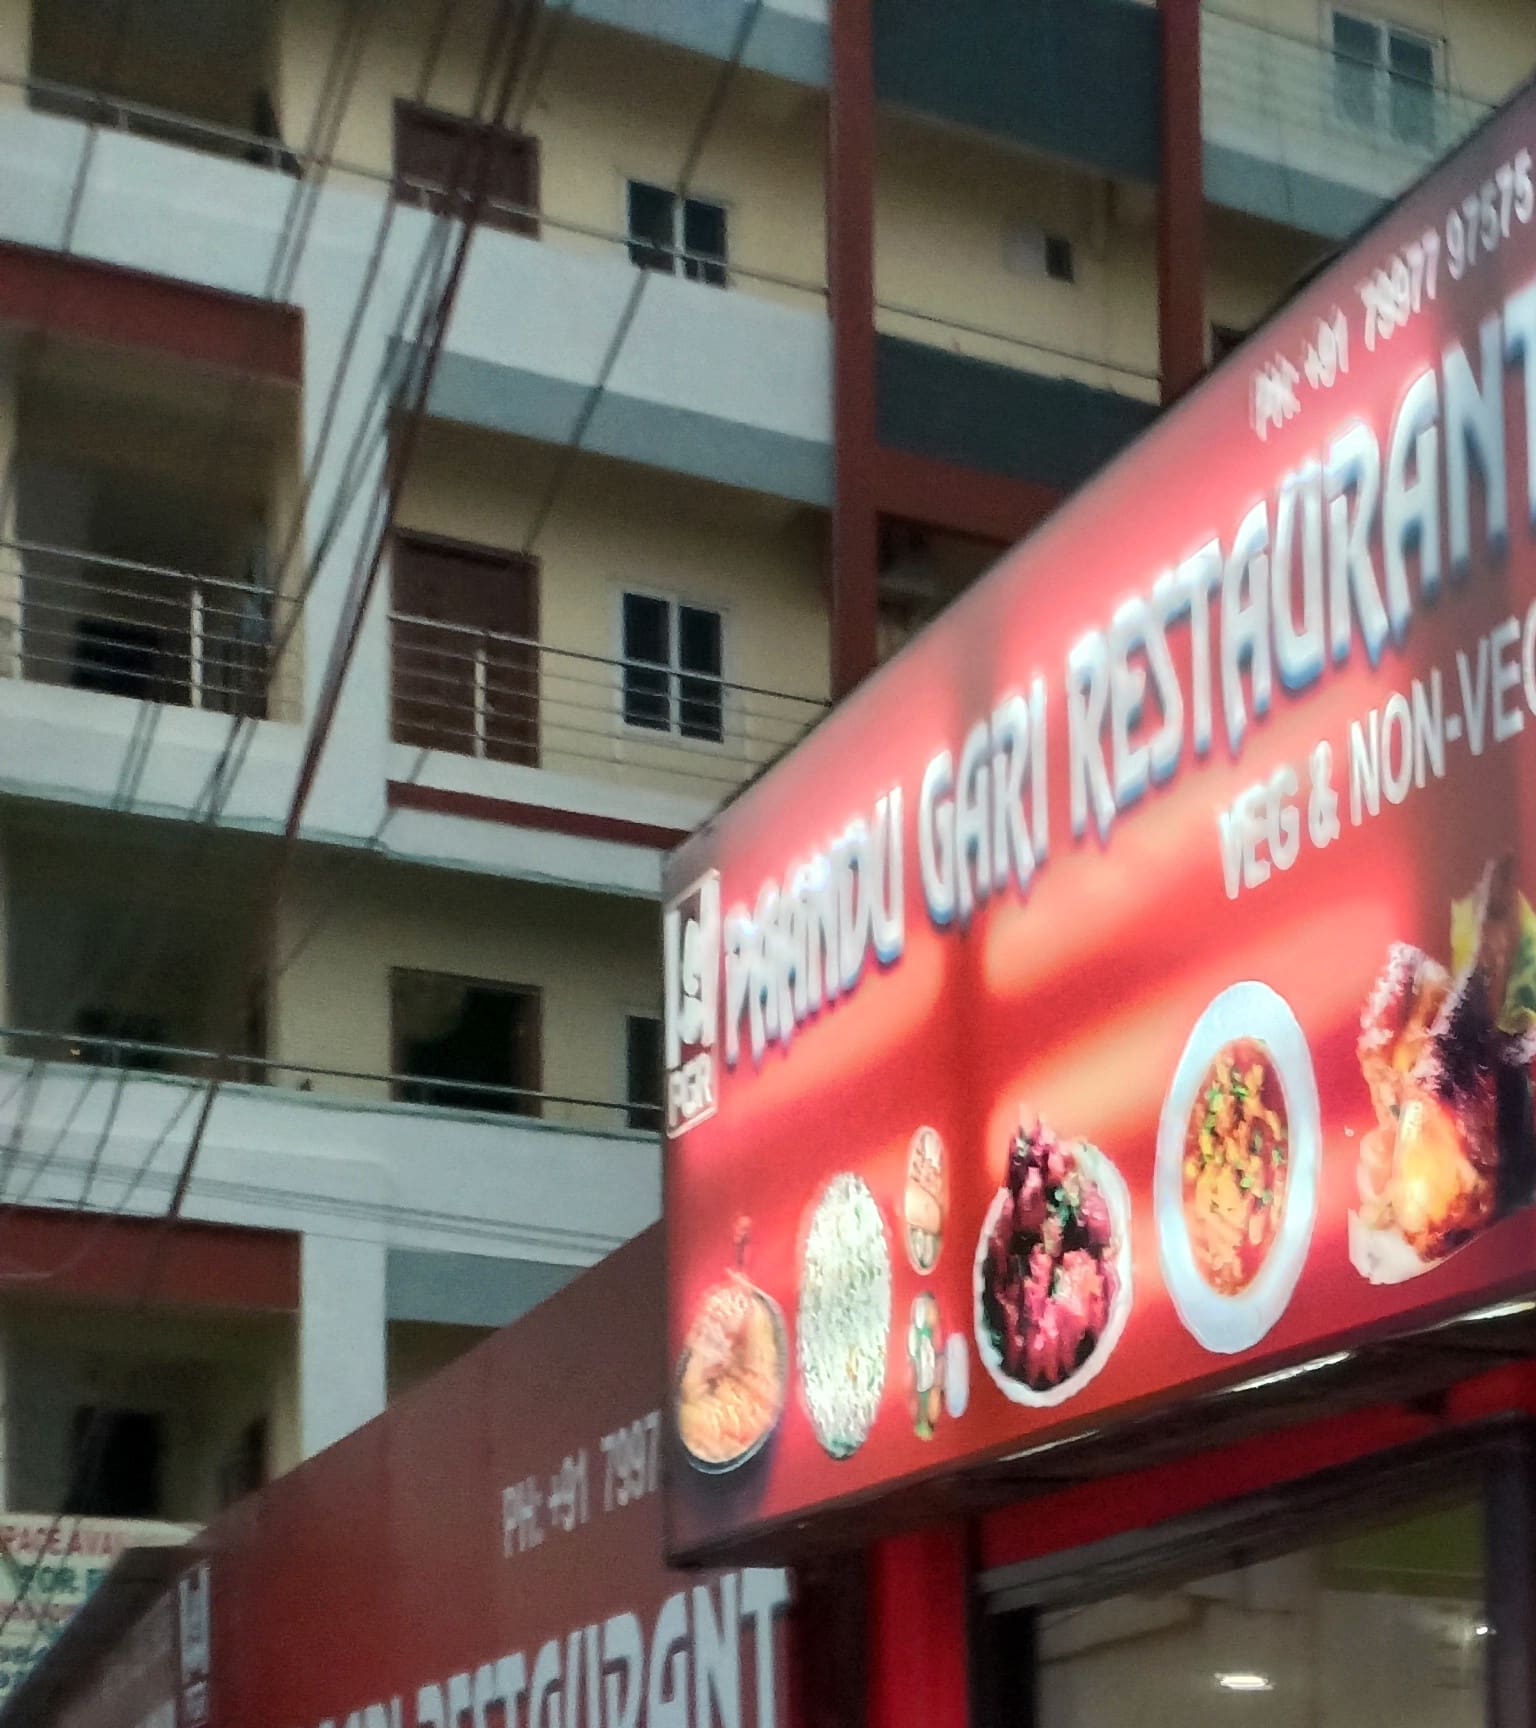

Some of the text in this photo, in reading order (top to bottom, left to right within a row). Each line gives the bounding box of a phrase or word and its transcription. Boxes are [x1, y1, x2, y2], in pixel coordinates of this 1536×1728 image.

[1445, 146, 1535, 281] 97575
[918, 676, 1049, 932] GARI
[1219, 764, 1300, 900] VEG
[1308, 739, 1341, 849] &
